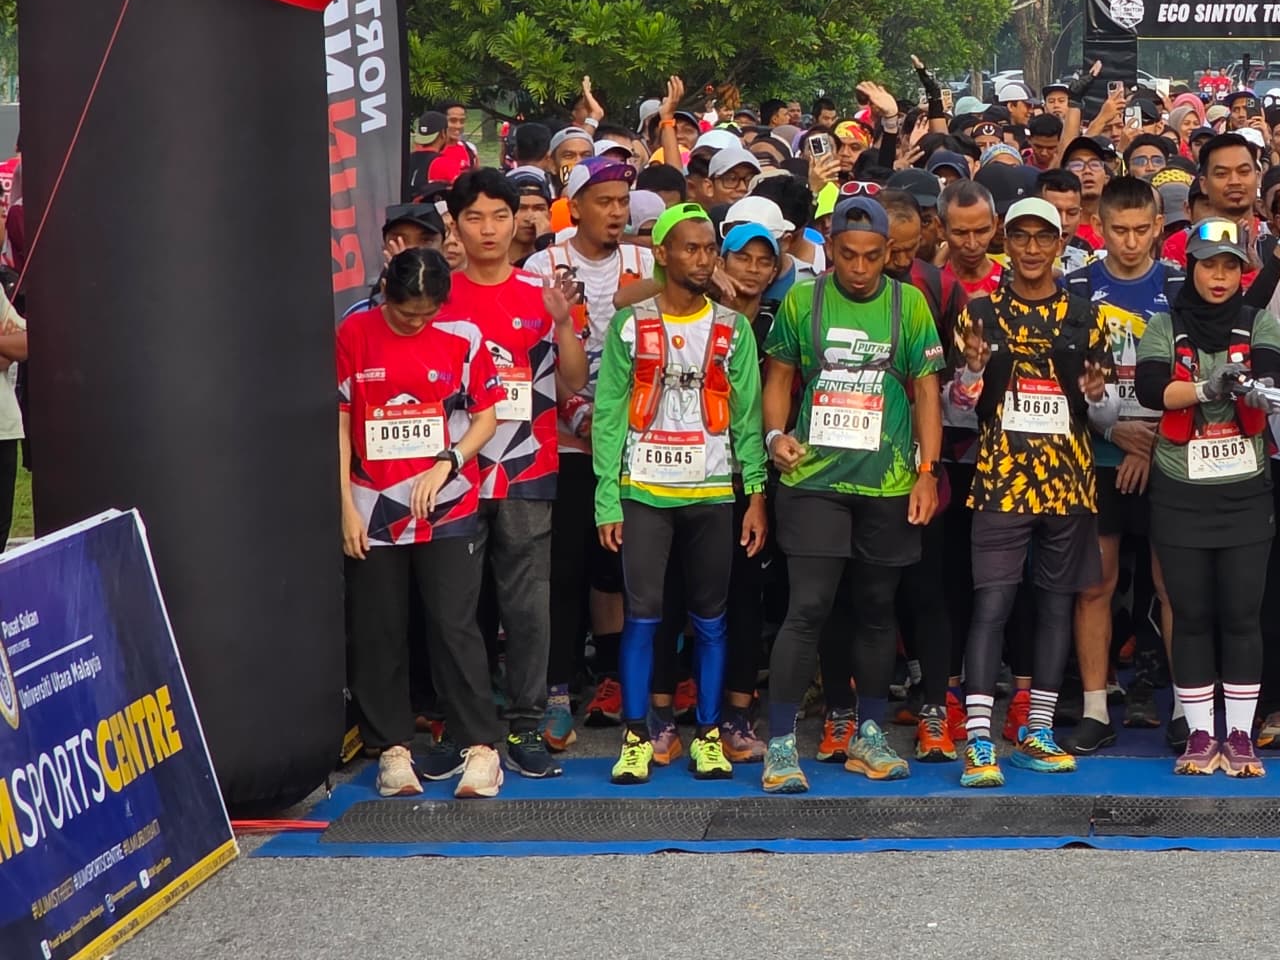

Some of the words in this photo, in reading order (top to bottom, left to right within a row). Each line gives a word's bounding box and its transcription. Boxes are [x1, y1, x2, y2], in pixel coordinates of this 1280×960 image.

[1157, 3, 1190, 22] ECO
[1194, 3, 1256, 23] SINTOK
[816, 381, 883, 394] FINISHER
[823, 412, 870, 429] C0200
[381, 424, 431, 440] D0548
[646, 449, 692, 465] E0645
[1201, 441, 1246, 459] D0503
[18, 674, 53, 710] Universiti
[50, 670, 72, 693] Utara
[70, 651, 102, 683] Malaysia
